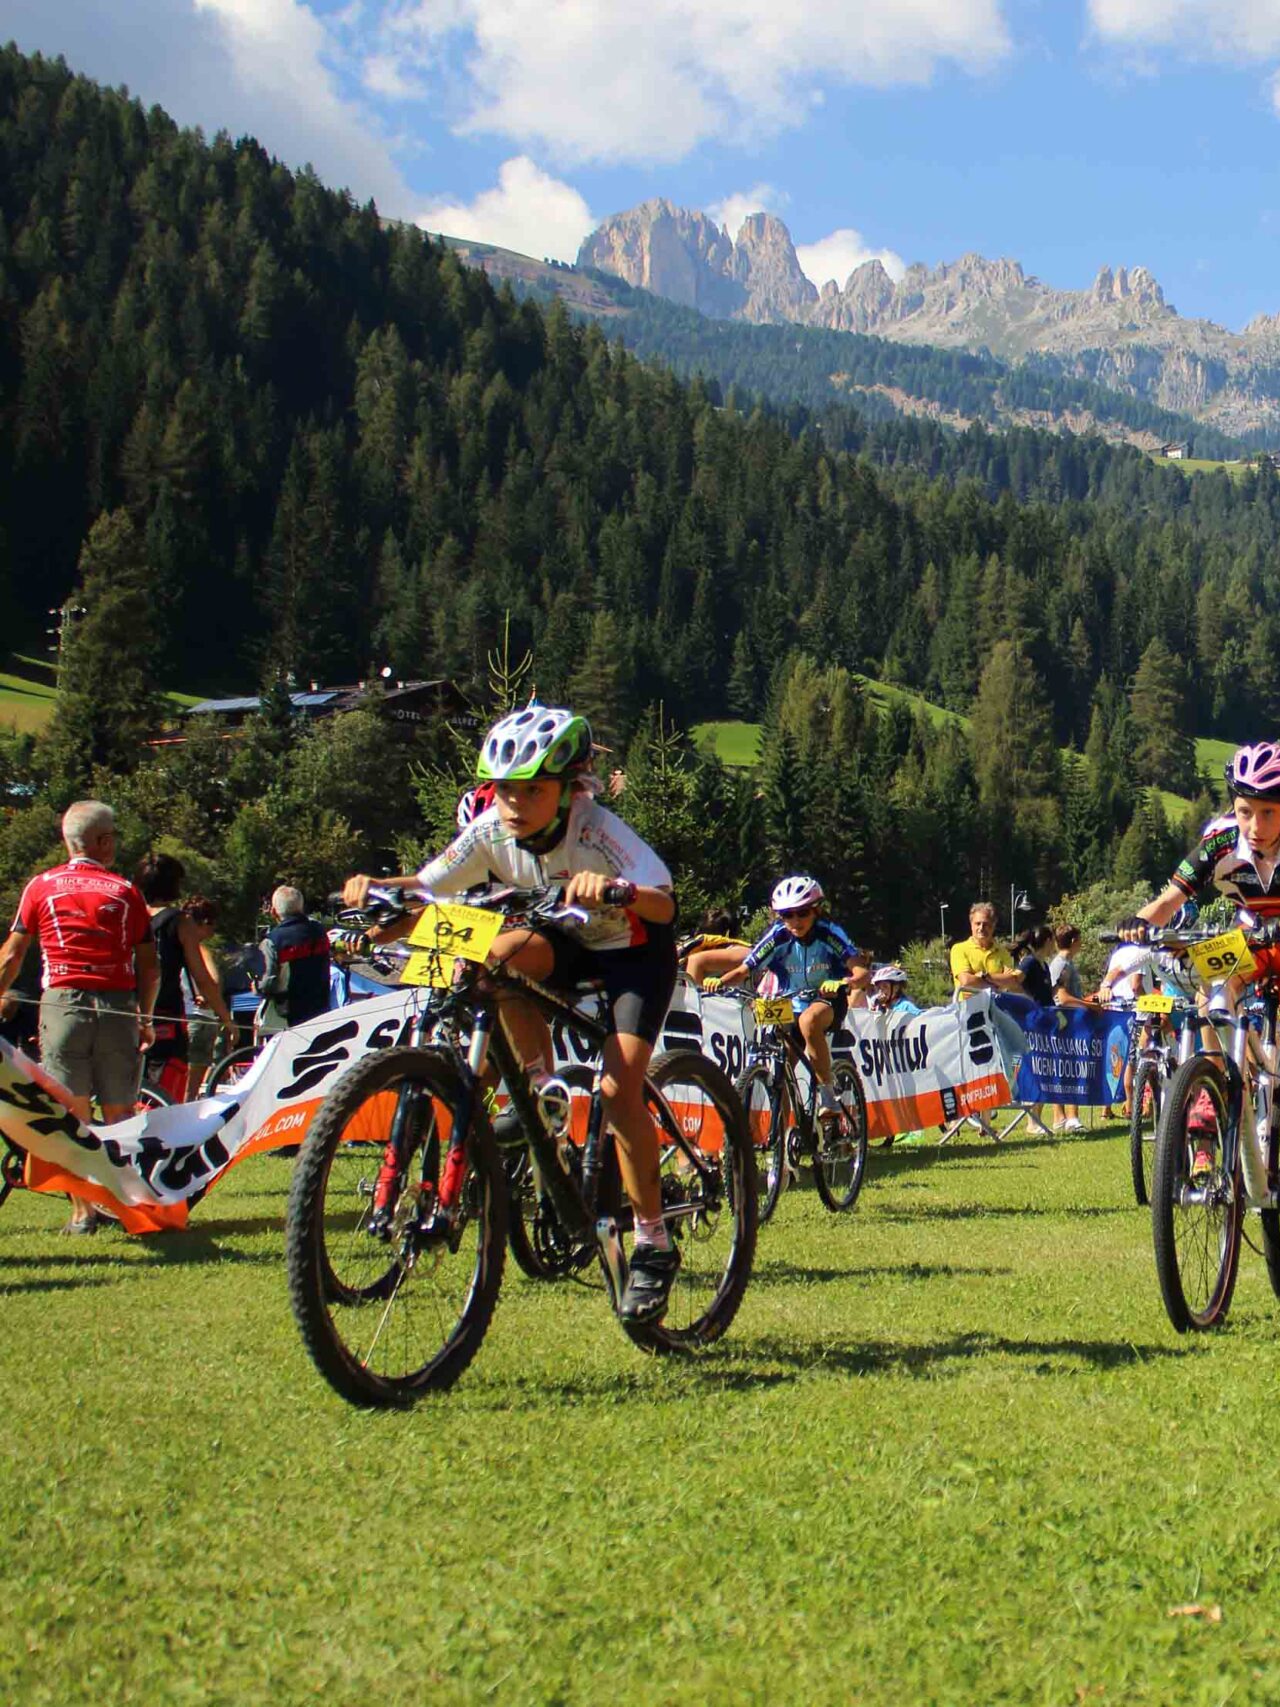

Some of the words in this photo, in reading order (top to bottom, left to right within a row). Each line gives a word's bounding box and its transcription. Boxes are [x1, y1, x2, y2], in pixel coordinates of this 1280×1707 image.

[434, 921, 474, 943] 64
[1206, 951, 1238, 971] 98
[859, 1023, 929, 1087] sportful
[1050, 1035, 1090, 1057] ITALIANA
[1031, 1055, 1057, 1078] MOENA
[1058, 1058, 1097, 1080] DOLOMITI
